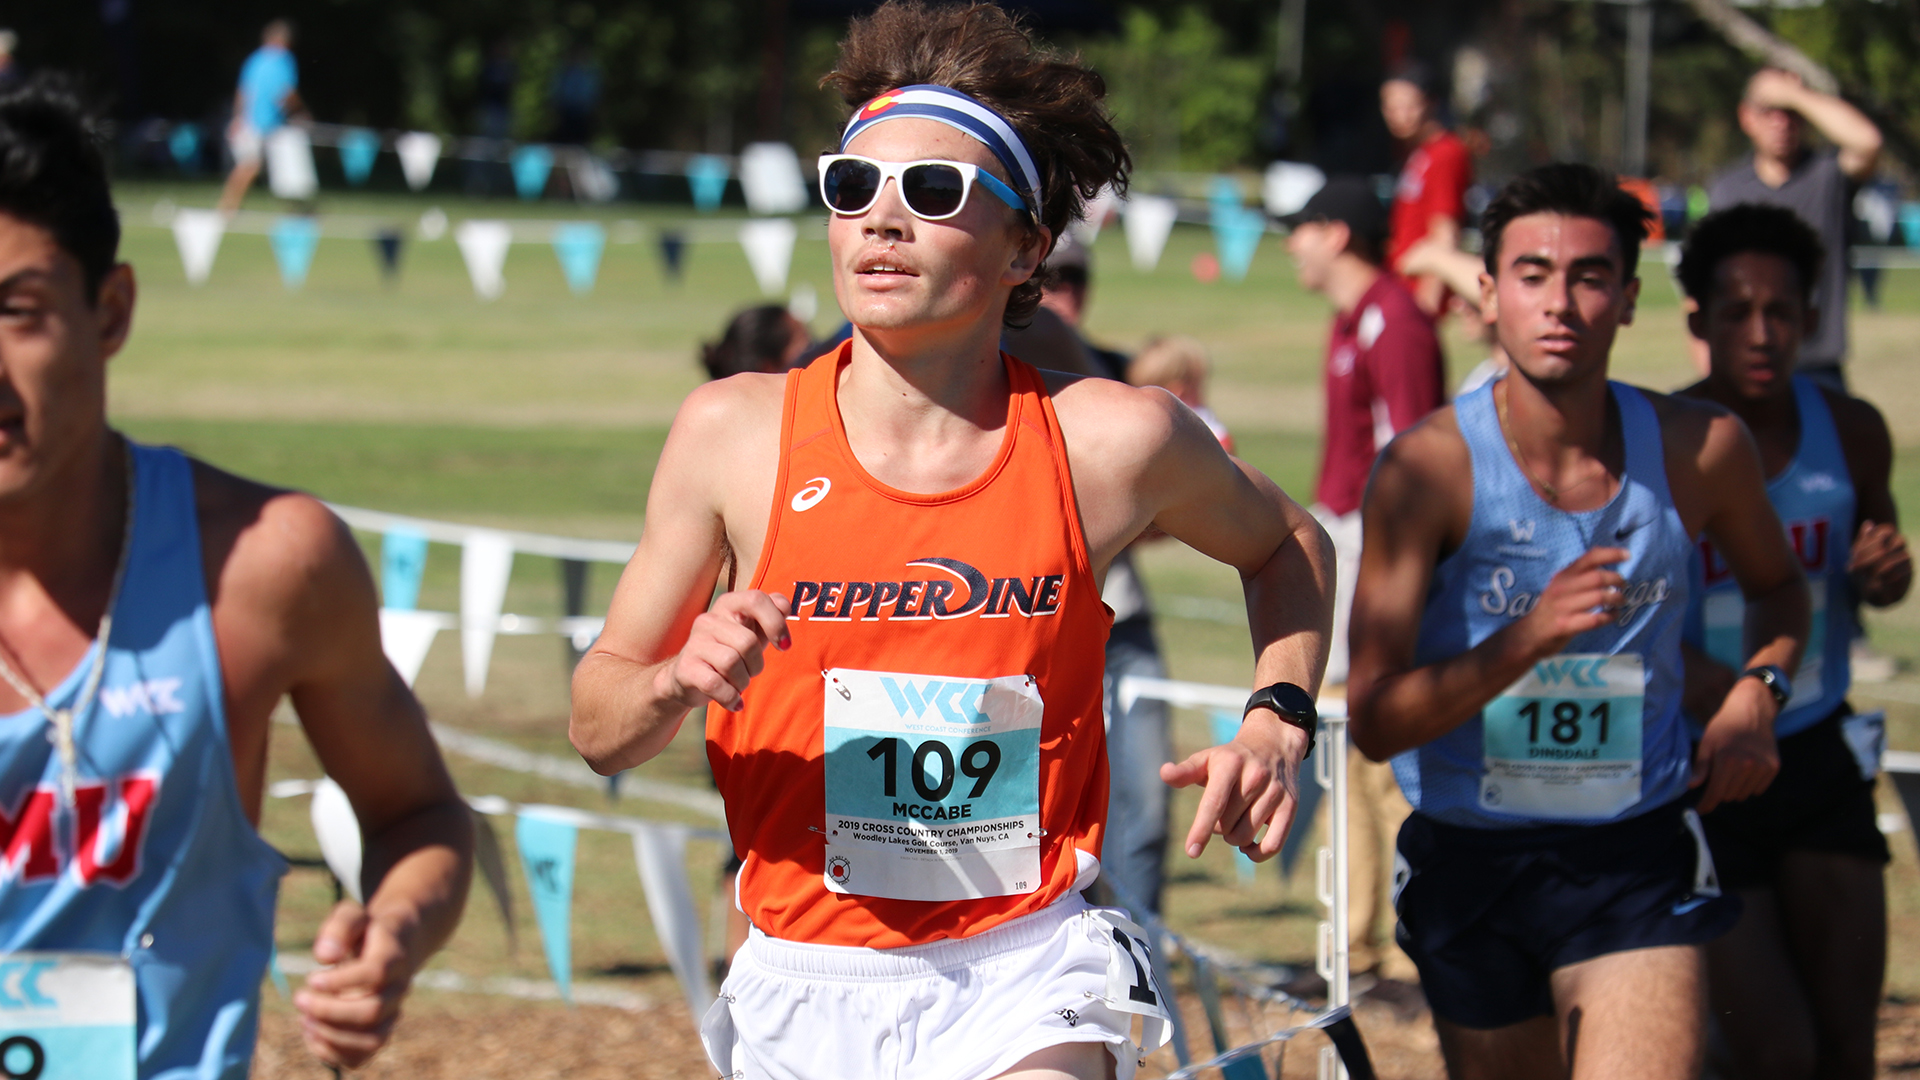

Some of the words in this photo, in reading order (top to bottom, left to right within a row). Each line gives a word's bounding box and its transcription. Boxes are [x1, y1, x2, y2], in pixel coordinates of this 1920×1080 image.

[786, 557, 1065, 621] PEPPERDINE
[1534, 658, 1609, 687] WCC
[880, 676, 994, 725] WCC
[905, 723, 924, 731] WEST
[925, 725, 947, 733] COAST
[948, 725, 992, 735] CONFERENCE
[1518, 700, 1611, 746] 181
[1528, 747, 1600, 760] DINSDALE
[866, 737, 1002, 803] 109
[893, 803, 972, 821] MCCABE
[838, 820, 860, 830] 2019
[862, 823, 894, 834] CROSS
[897, 826, 944, 838] COUNTRY
[947, 820, 1025, 838] CHAMPIONSHIPS
[853, 832, 887, 844] Woodley
[888, 836, 910, 845] Lakes
[911, 838, 927, 847] Golf
[930, 840, 958, 848] Course,
[960, 837, 975, 845] Van
[976, 835, 997, 844] Nuys,
[998, 832, 1010, 841] CA
[904, 847, 938, 855] NOVEMBER
[945, 847, 958, 855] 2019
[1015, 881, 1027, 890] 109
[1113, 927, 1158, 1007] 1
